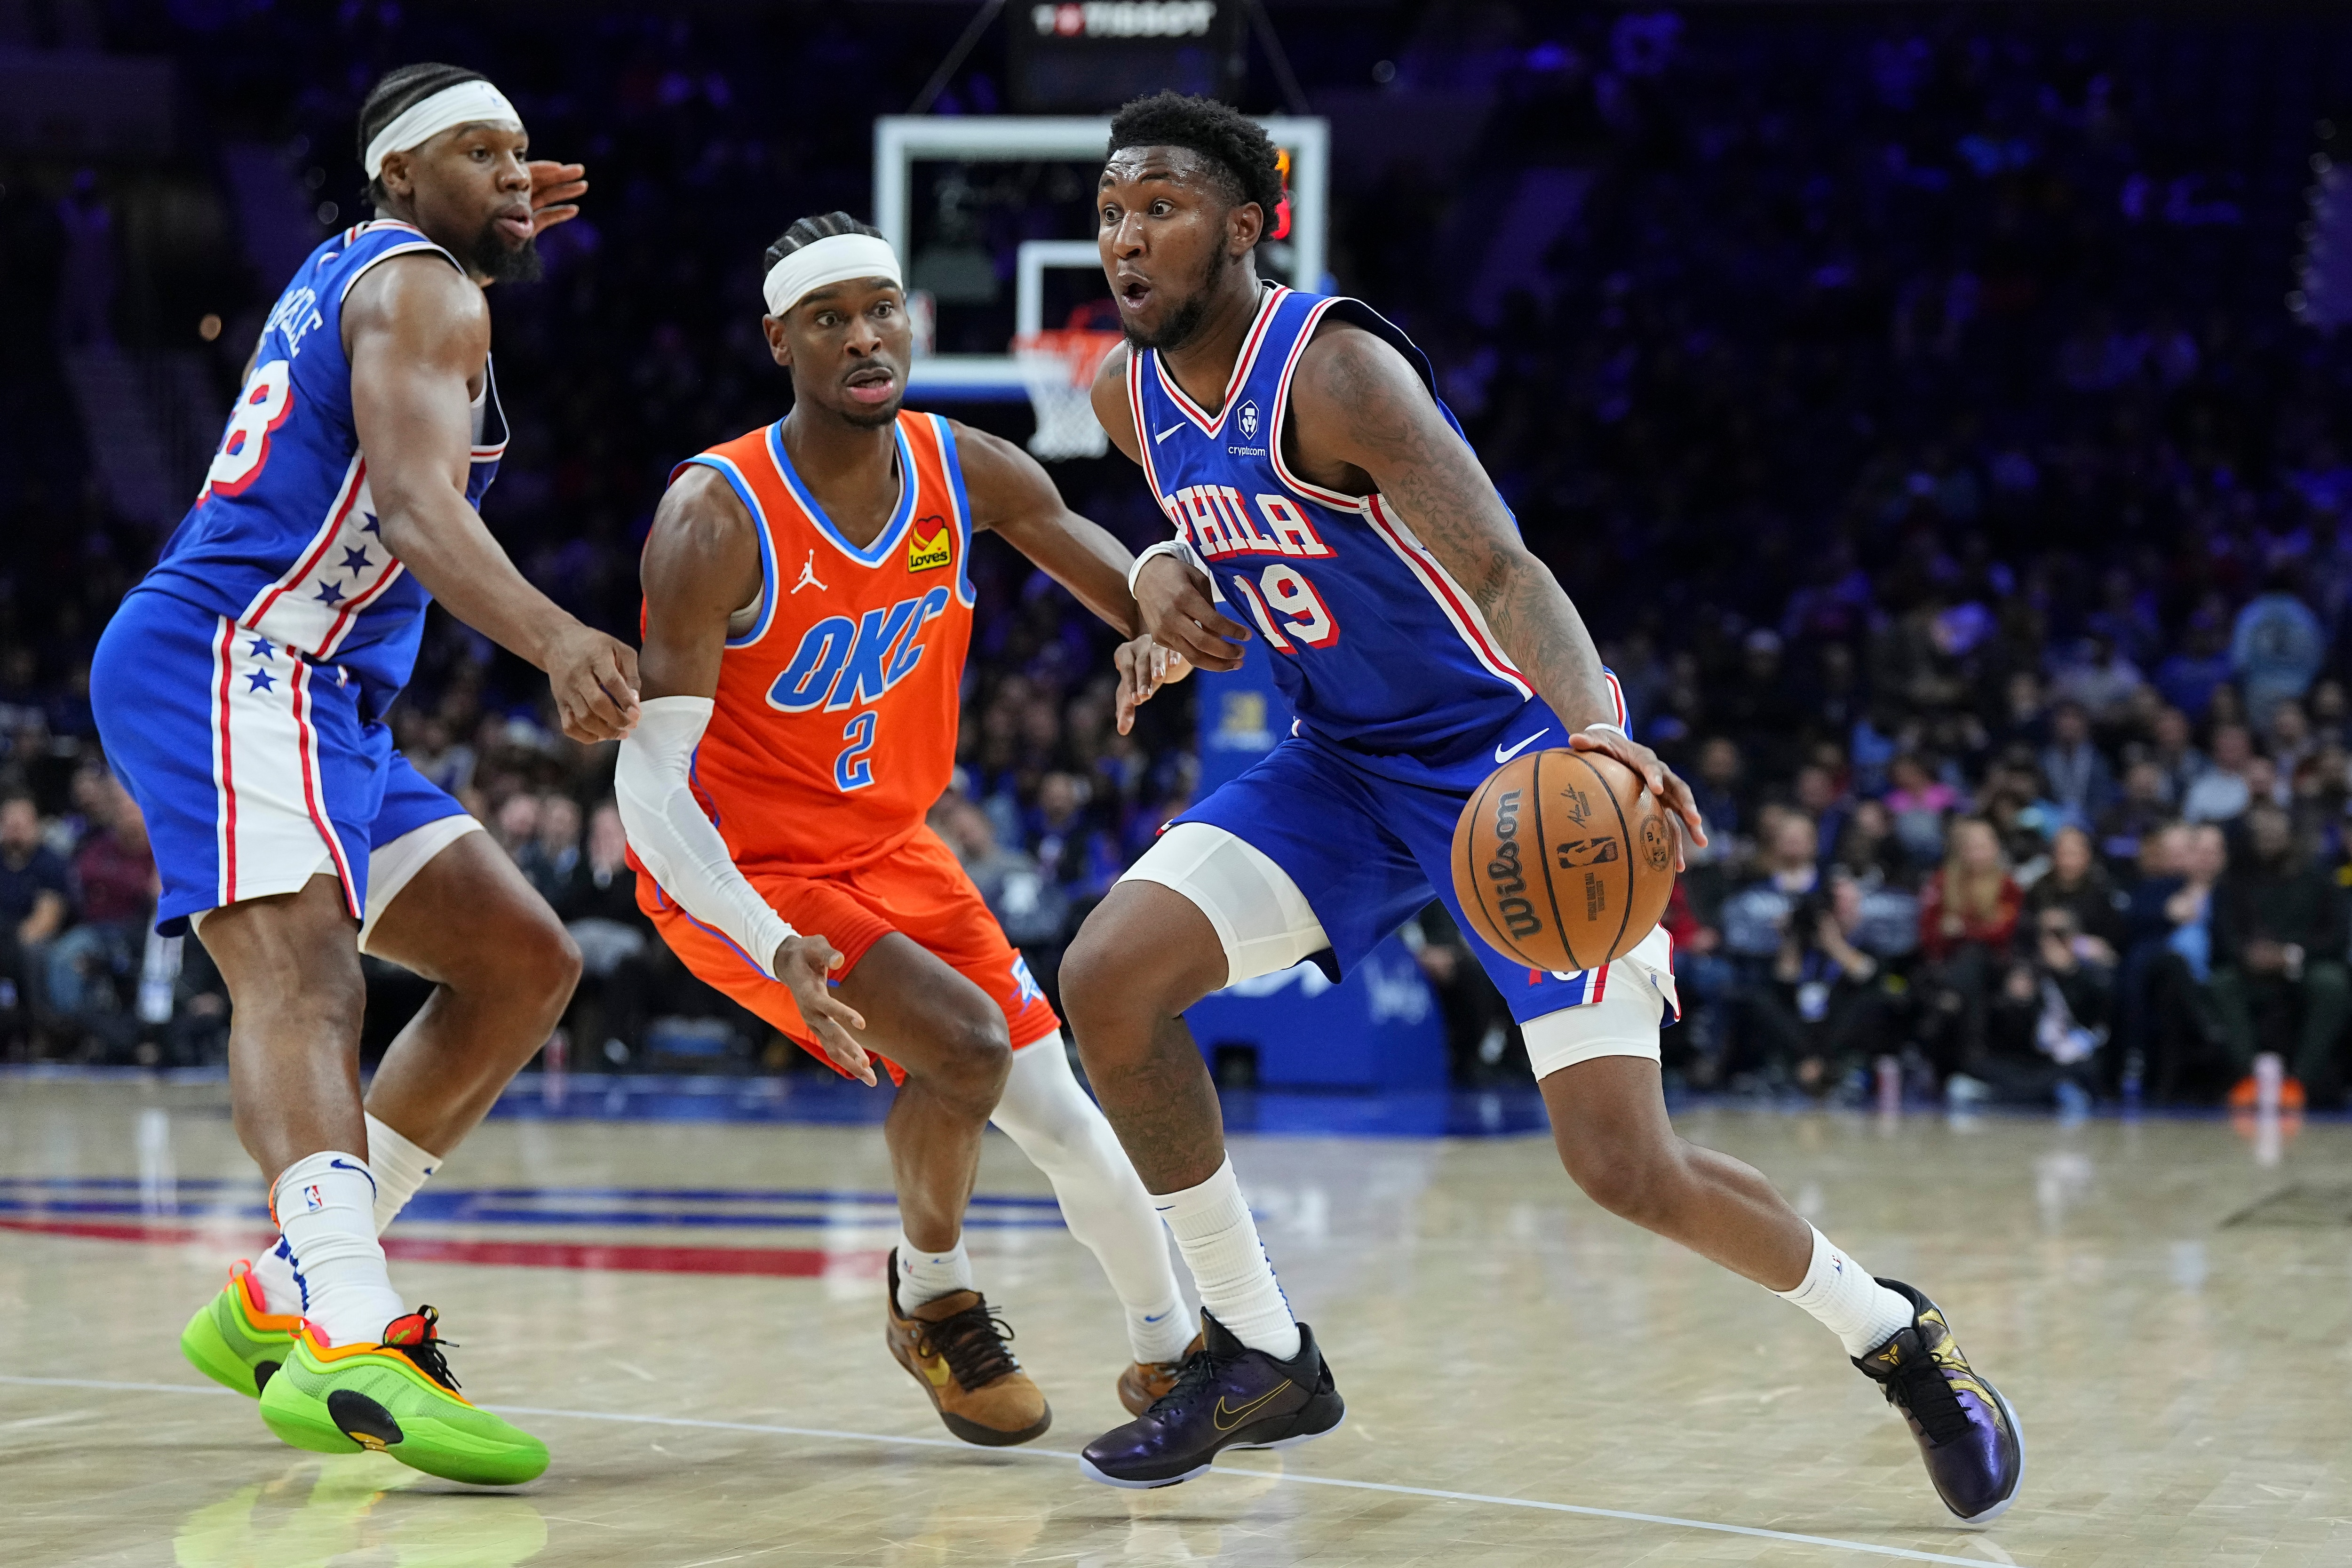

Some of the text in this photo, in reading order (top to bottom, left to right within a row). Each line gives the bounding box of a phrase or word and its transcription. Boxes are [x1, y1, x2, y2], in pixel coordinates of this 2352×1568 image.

[1164, 484, 1339, 562] PHILA
[765, 586, 951, 713] OKC
[1233, 563, 1341, 654] 19
[834, 710, 877, 792] 2
[1487, 788, 1543, 941] Wilson
